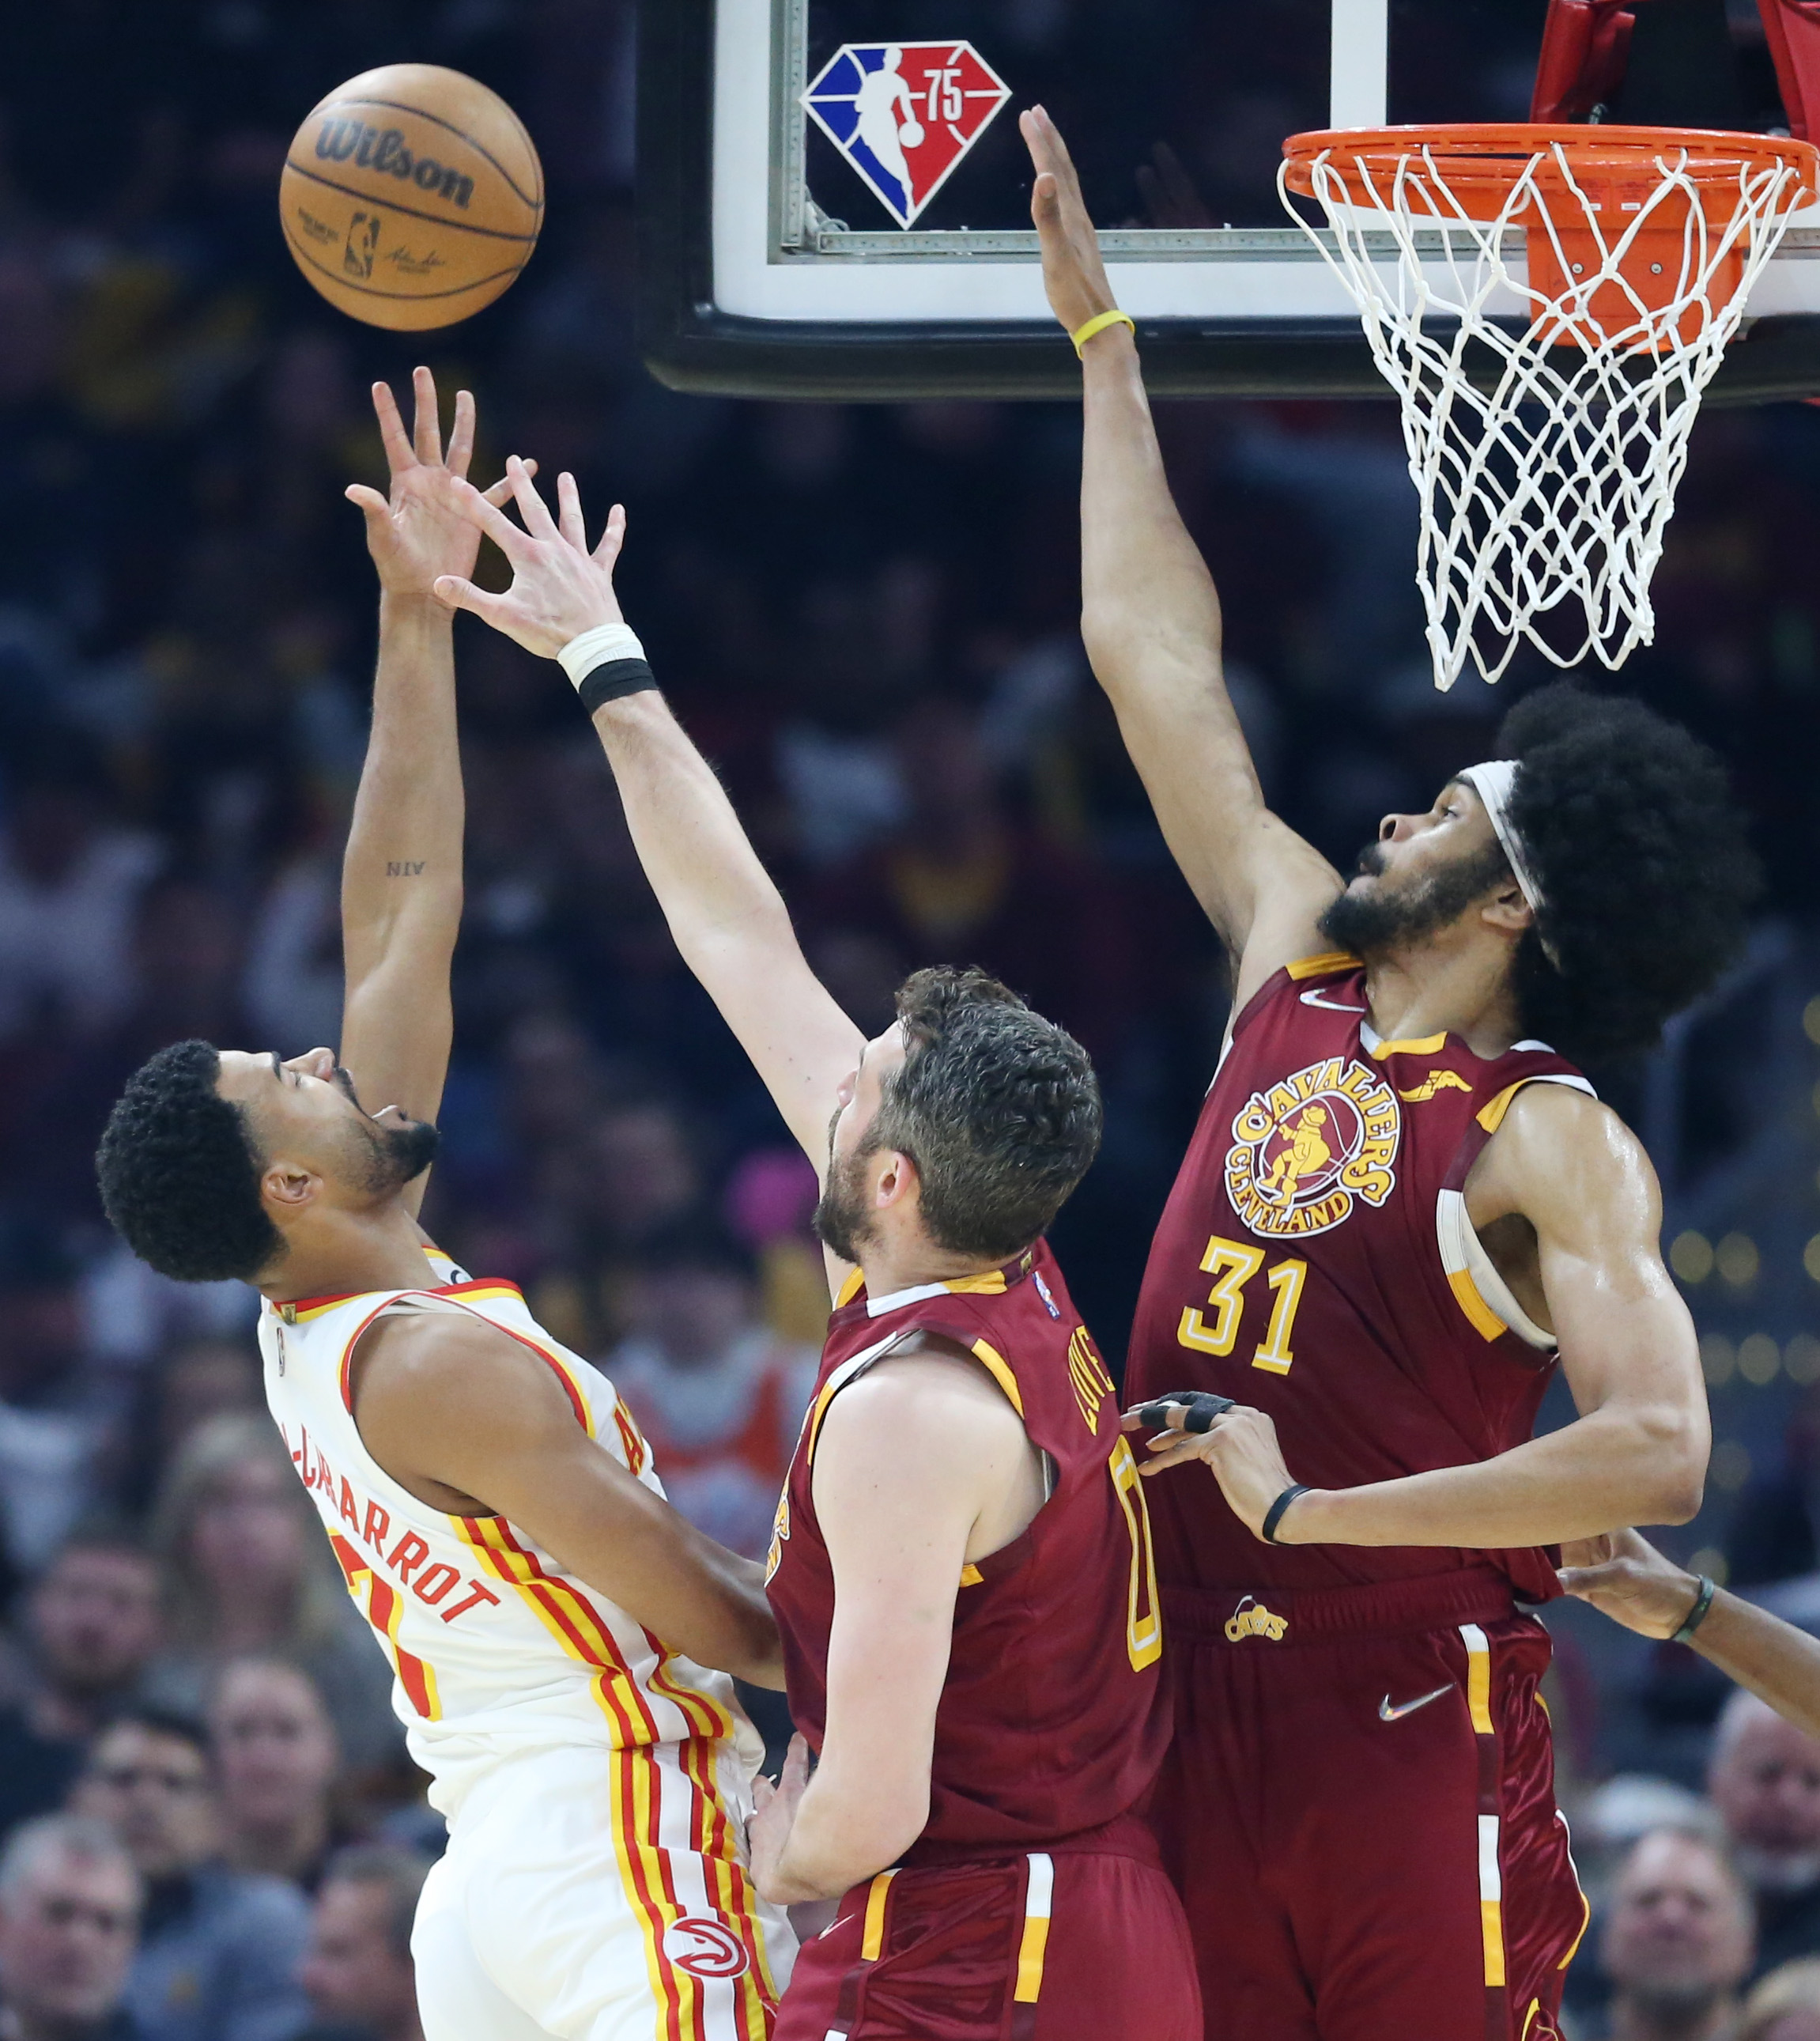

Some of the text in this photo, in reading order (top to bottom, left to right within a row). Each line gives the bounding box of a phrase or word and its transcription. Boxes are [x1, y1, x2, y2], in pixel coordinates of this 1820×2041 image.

[923, 69, 962, 121] 75
[315, 117, 474, 210] Wilson
[1233, 1057, 1400, 1206] CAVALIERS
[1225, 1144, 1353, 1238] CLEVELAND
[1177, 1235, 1307, 1375] 31
[1108, 1434, 1162, 1672] 0
